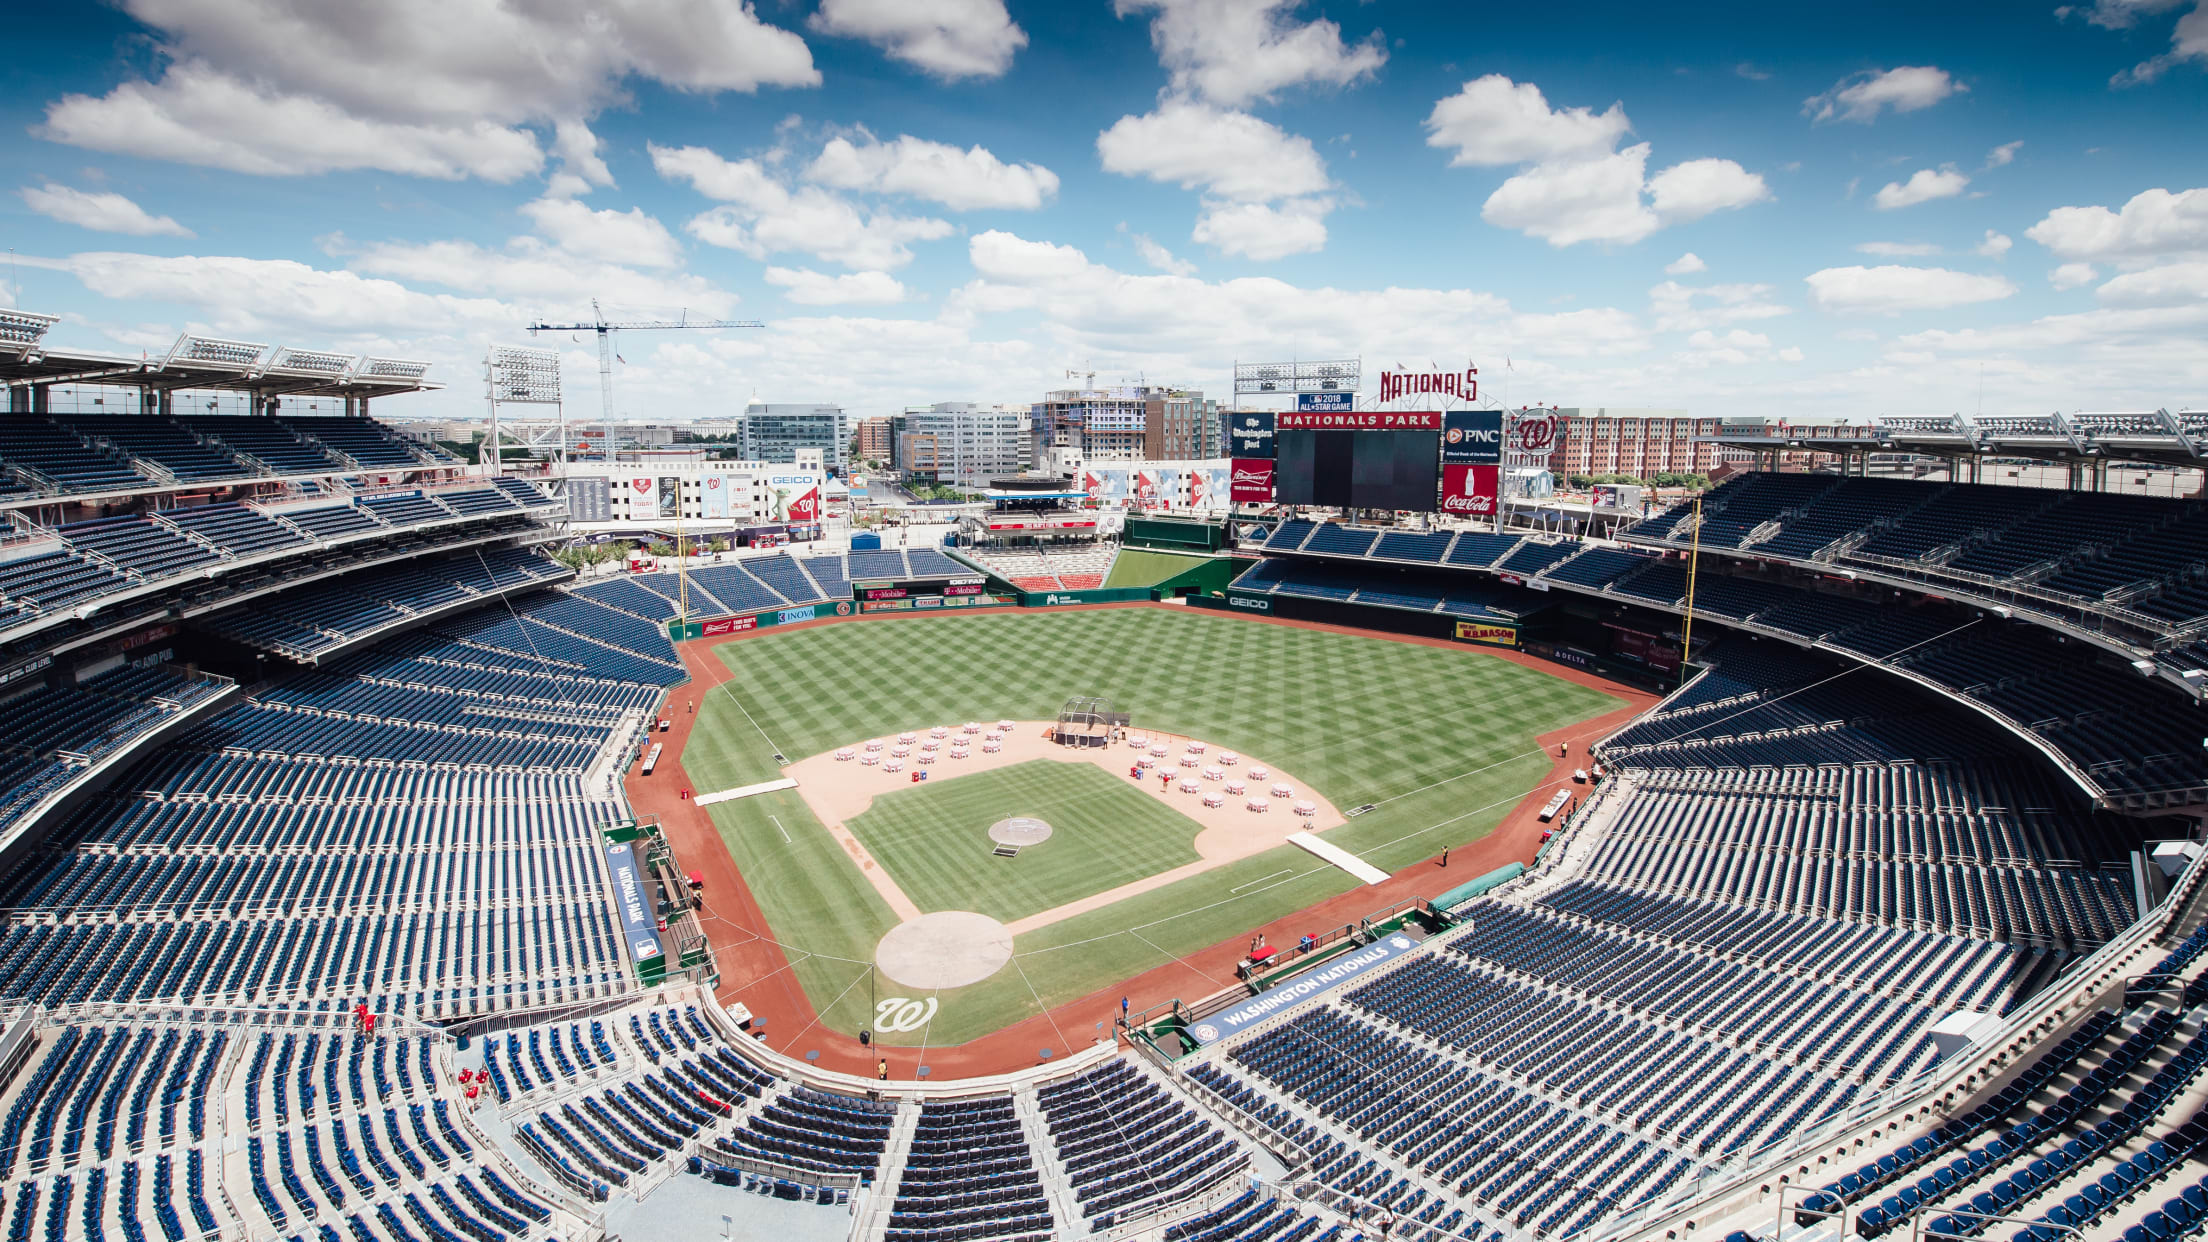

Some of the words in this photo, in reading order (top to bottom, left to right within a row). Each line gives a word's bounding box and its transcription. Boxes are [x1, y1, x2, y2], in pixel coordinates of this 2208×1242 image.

[1380, 369, 1478, 402] NATIONALS
[1332, 402, 1351, 411] GAME
[1283, 415, 1377, 425] NATIONALS
[1385, 415, 1431, 425] PARK
[1464, 430, 1499, 443] PNC
[772, 476, 813, 484] GEICO
[1230, 597, 1268, 609] GEICO
[788, 609, 814, 621] INOVA
[1562, 653, 1585, 665] DELTA
[617, 865, 639, 902] NATIONALS
[628, 902, 645, 924] PARK
[1223, 978, 1321, 1026] WASHINGTON
[1316, 946, 1389, 984] NATIONALS
[873, 997, 938, 1033] W
